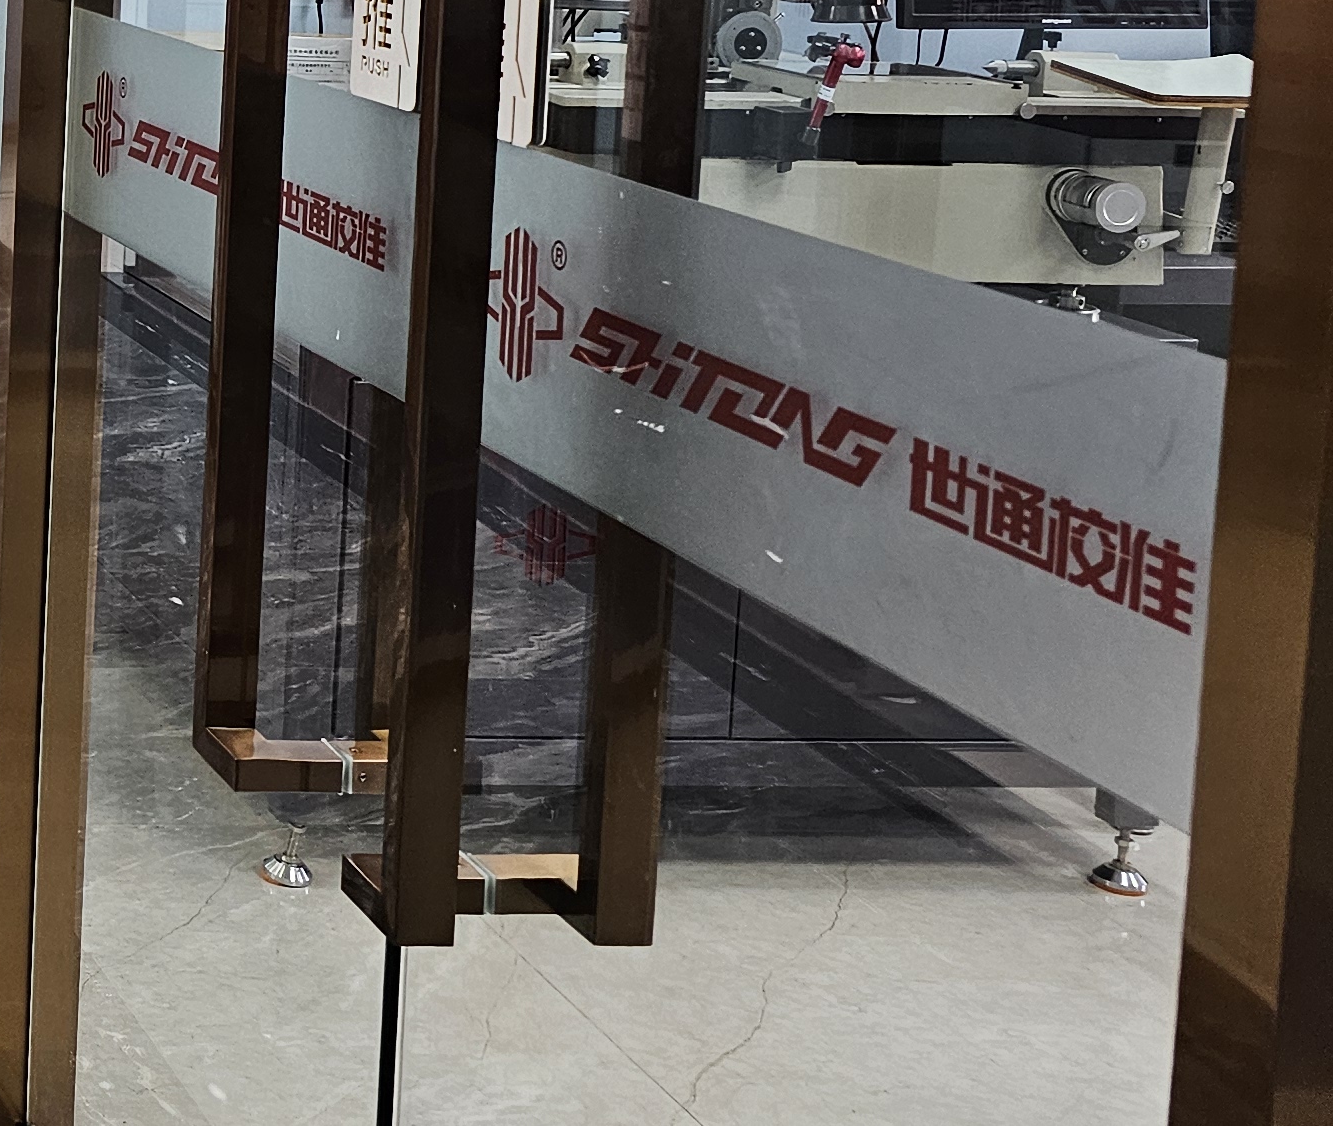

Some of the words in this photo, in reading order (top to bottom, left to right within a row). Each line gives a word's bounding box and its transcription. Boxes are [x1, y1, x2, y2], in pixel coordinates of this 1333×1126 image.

[361, 55, 389, 78] PUSH
[280, 178, 386, 272] 世通校准
[909, 436, 1198, 637] 世通校准
